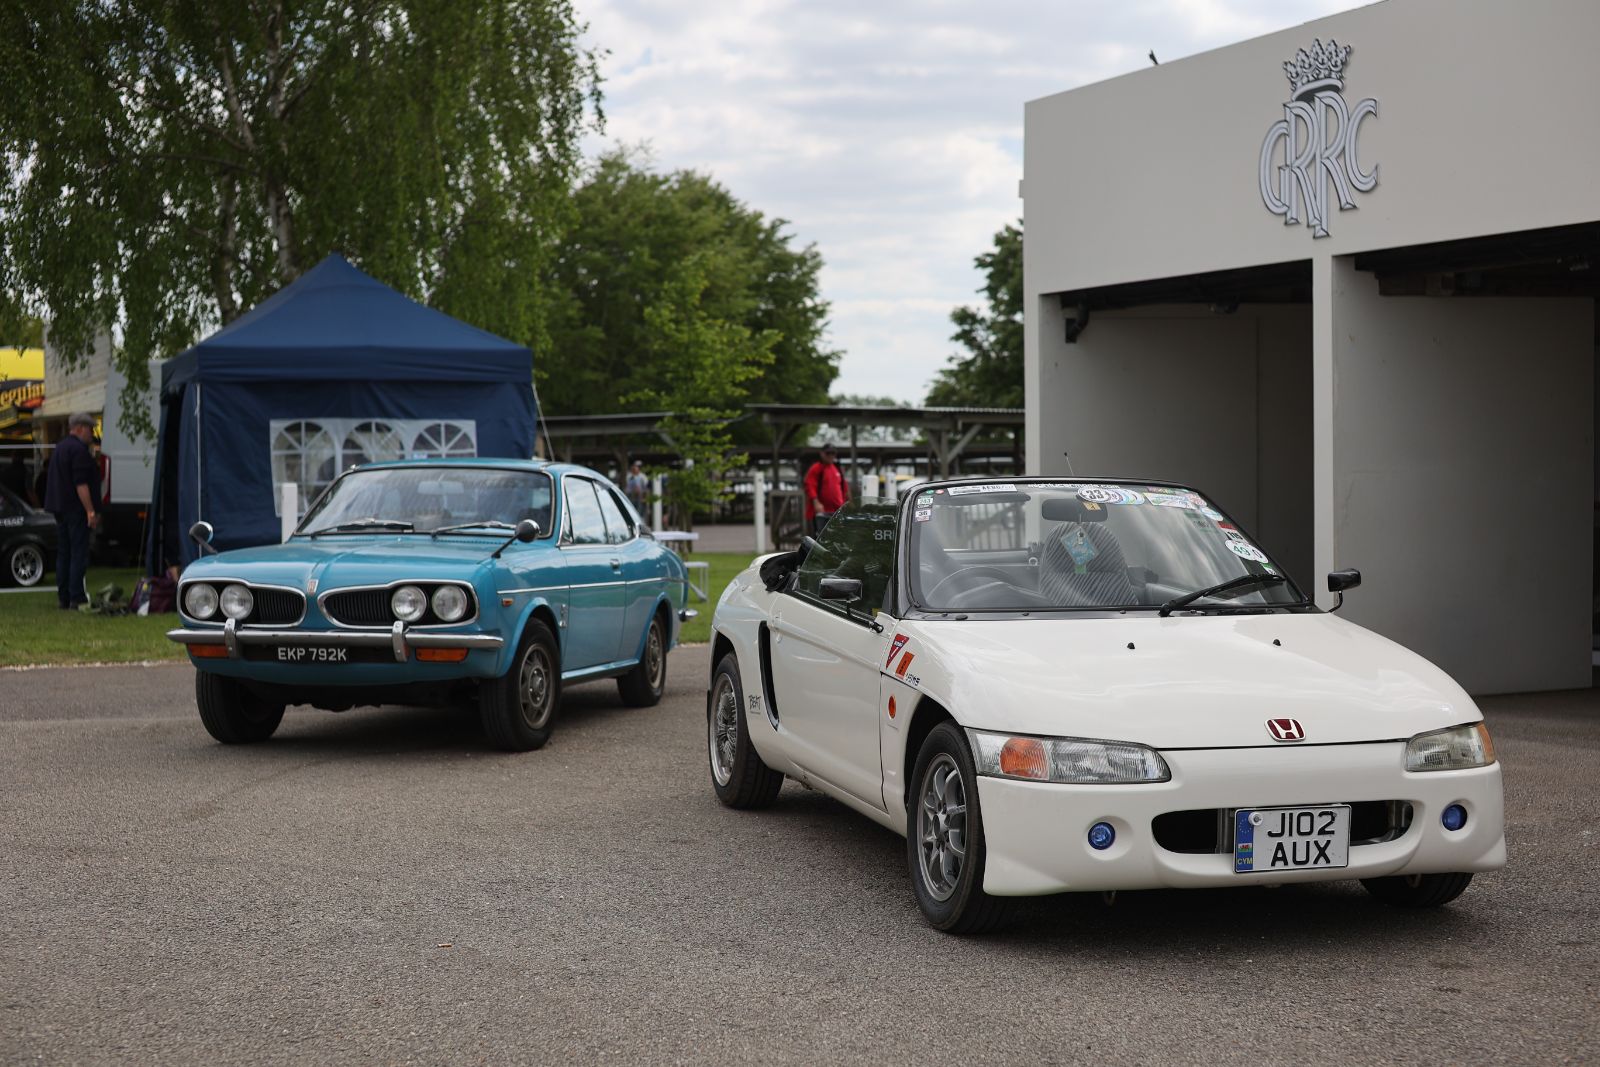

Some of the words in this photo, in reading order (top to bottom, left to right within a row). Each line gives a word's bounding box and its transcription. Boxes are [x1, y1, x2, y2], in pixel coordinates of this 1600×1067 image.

[1259, 90, 1378, 239] GRRC
[277, 647, 306, 661] EKP
[308, 647, 347, 661] 792K
[1267, 810, 1336, 838] J102
[1237, 857, 1253, 866] CYM
[1270, 839, 1332, 867] AUX
